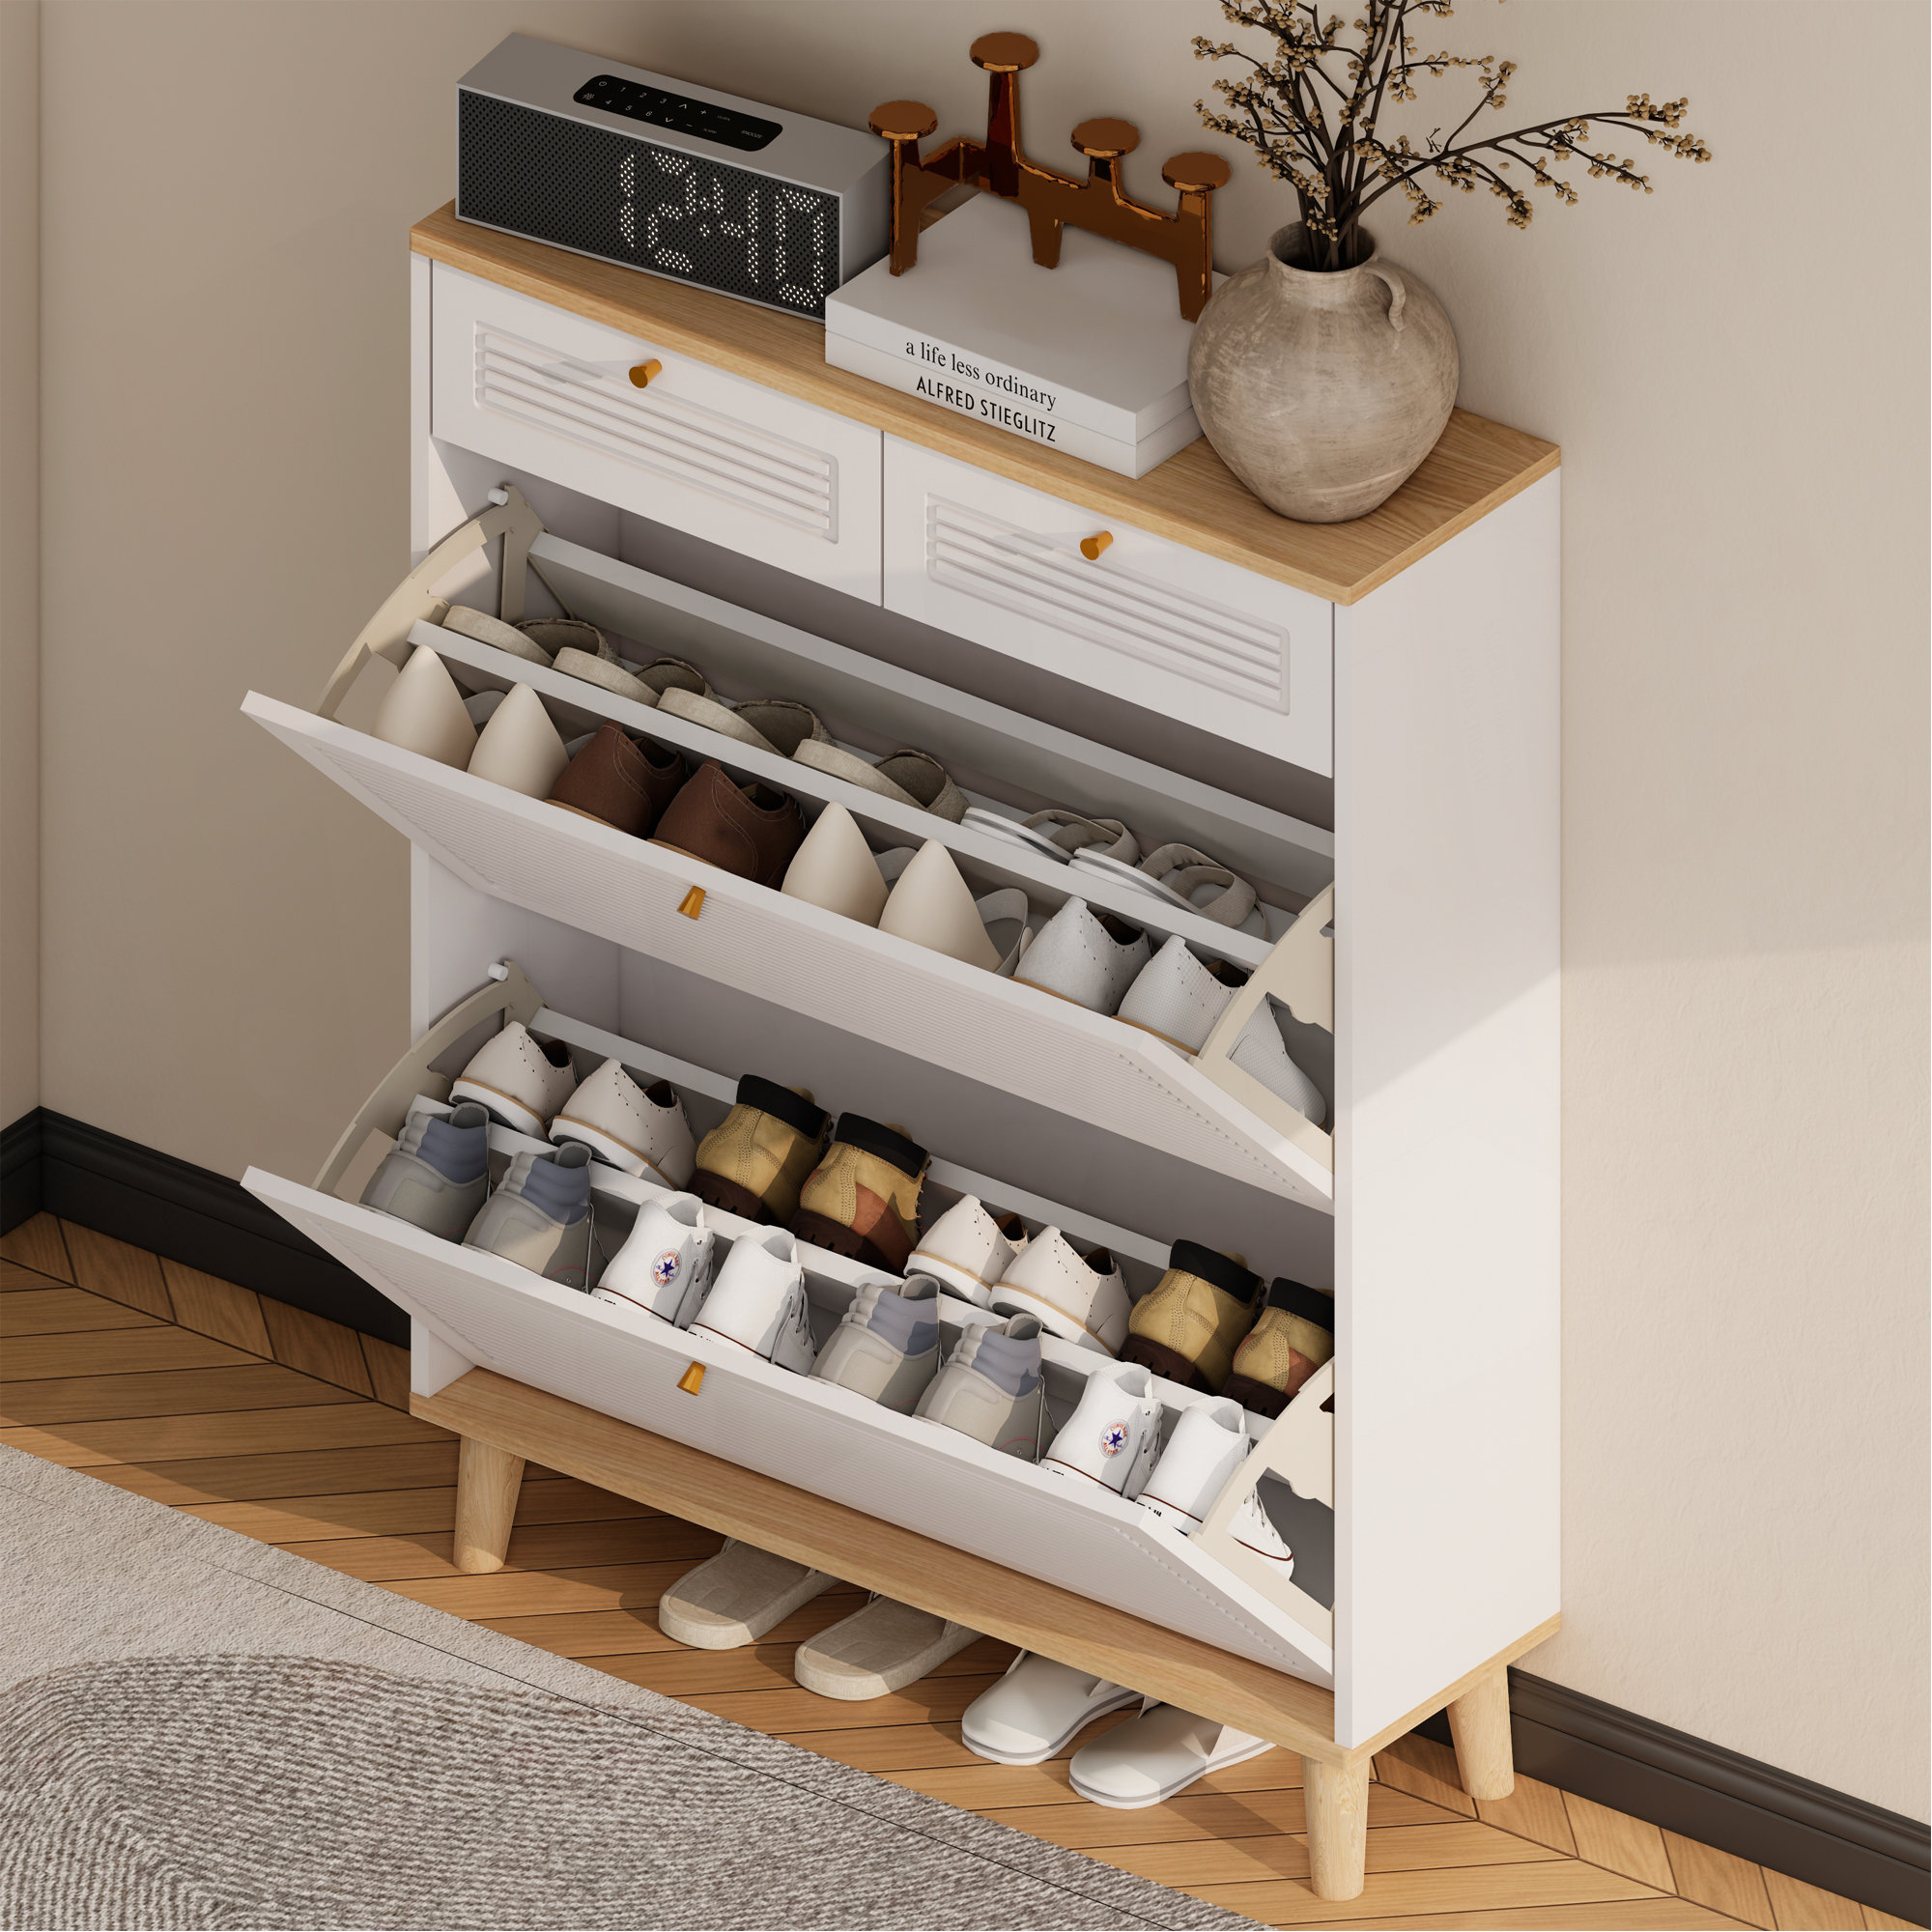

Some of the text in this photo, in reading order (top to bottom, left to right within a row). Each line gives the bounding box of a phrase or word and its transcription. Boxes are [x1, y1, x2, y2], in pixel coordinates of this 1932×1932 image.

[620, 151, 824, 308] 12:40
[906, 341, 1057, 412] a life less ordinary
[916, 376, 1056, 442] ALFRED STIEGLITZ
